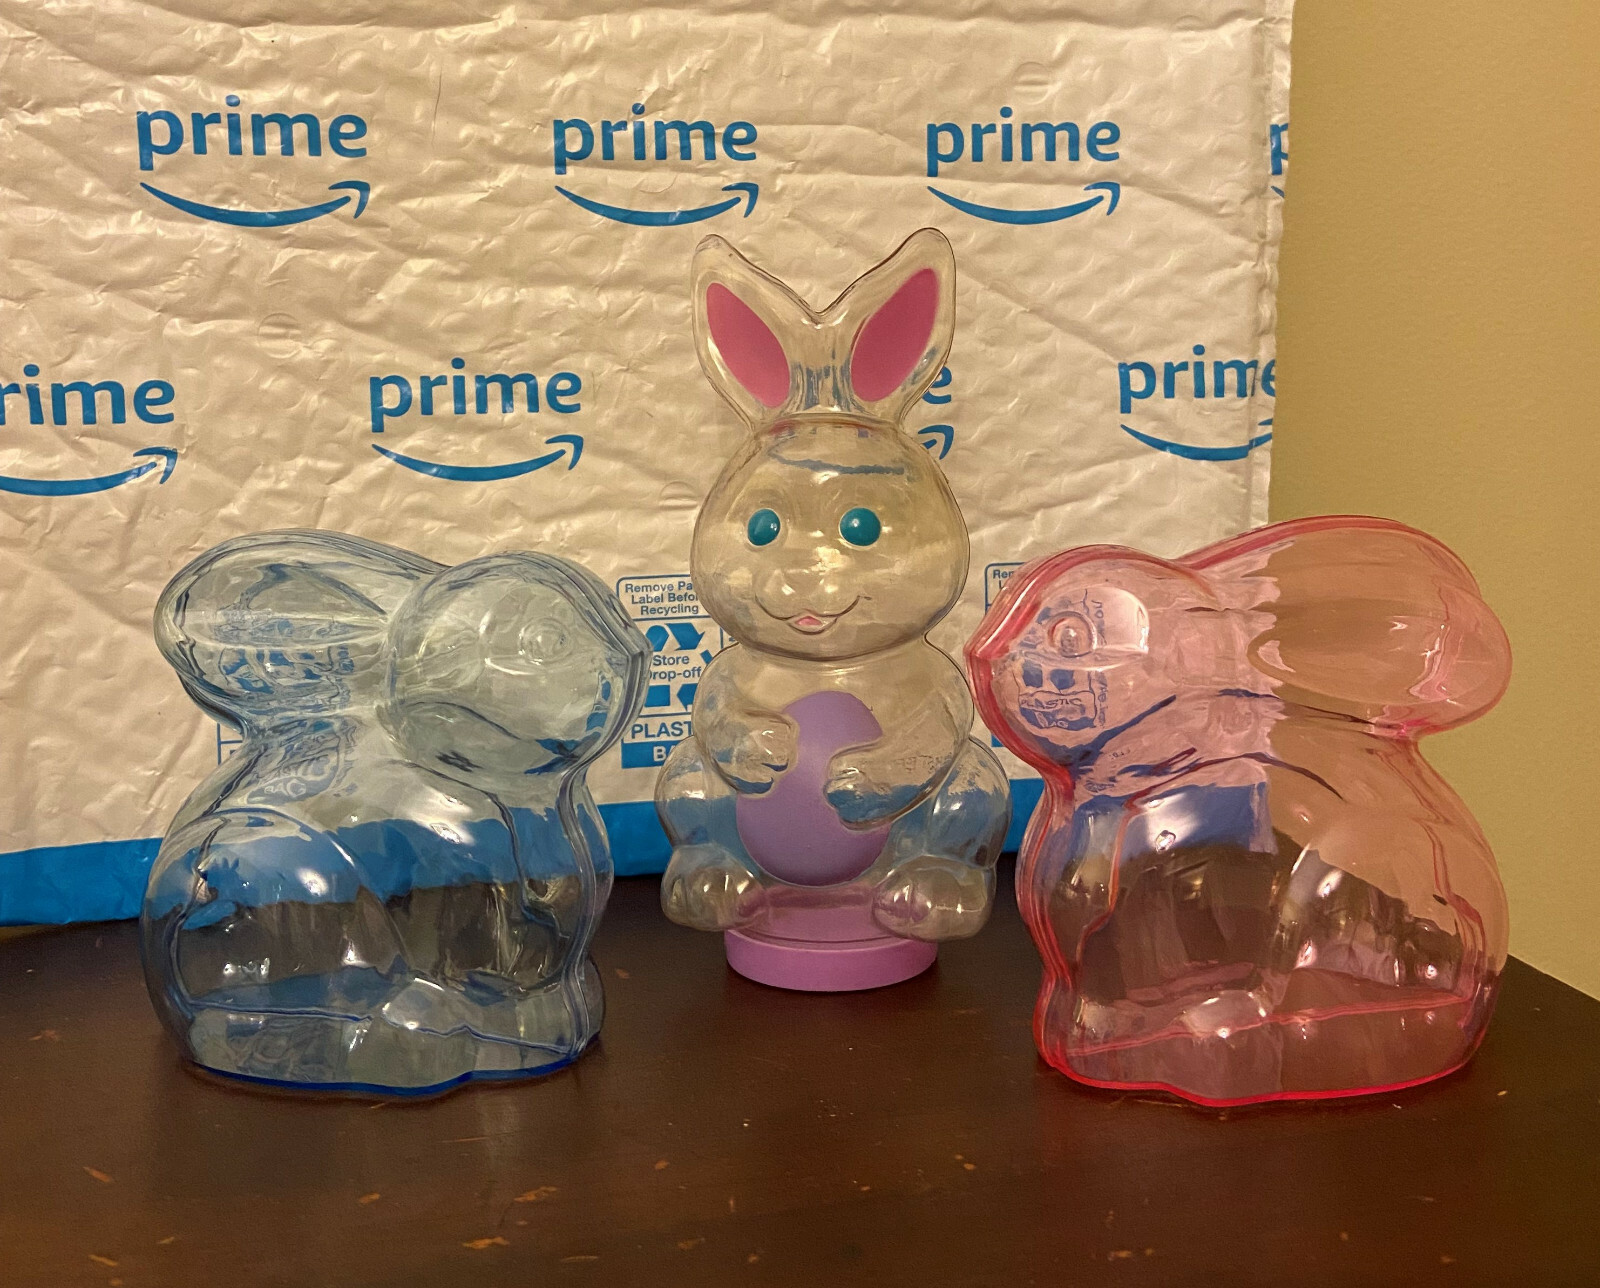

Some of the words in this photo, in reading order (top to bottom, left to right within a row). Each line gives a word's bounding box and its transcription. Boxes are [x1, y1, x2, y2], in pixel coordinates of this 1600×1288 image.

[136, 95, 367, 171] prime
[553, 103, 758, 175] prime
[927, 106, 1121, 177] prime
[0, 364, 174, 425] rime
[370, 358, 582, 433] prime
[625, 583, 674, 593] Remove
[631, 593, 664, 604] Label
[640, 604, 699, 616] Recycling
[653, 655, 689, 666] Store
[649, 667, 701, 681] rop-off
[631, 721, 692, 739] PLAST
